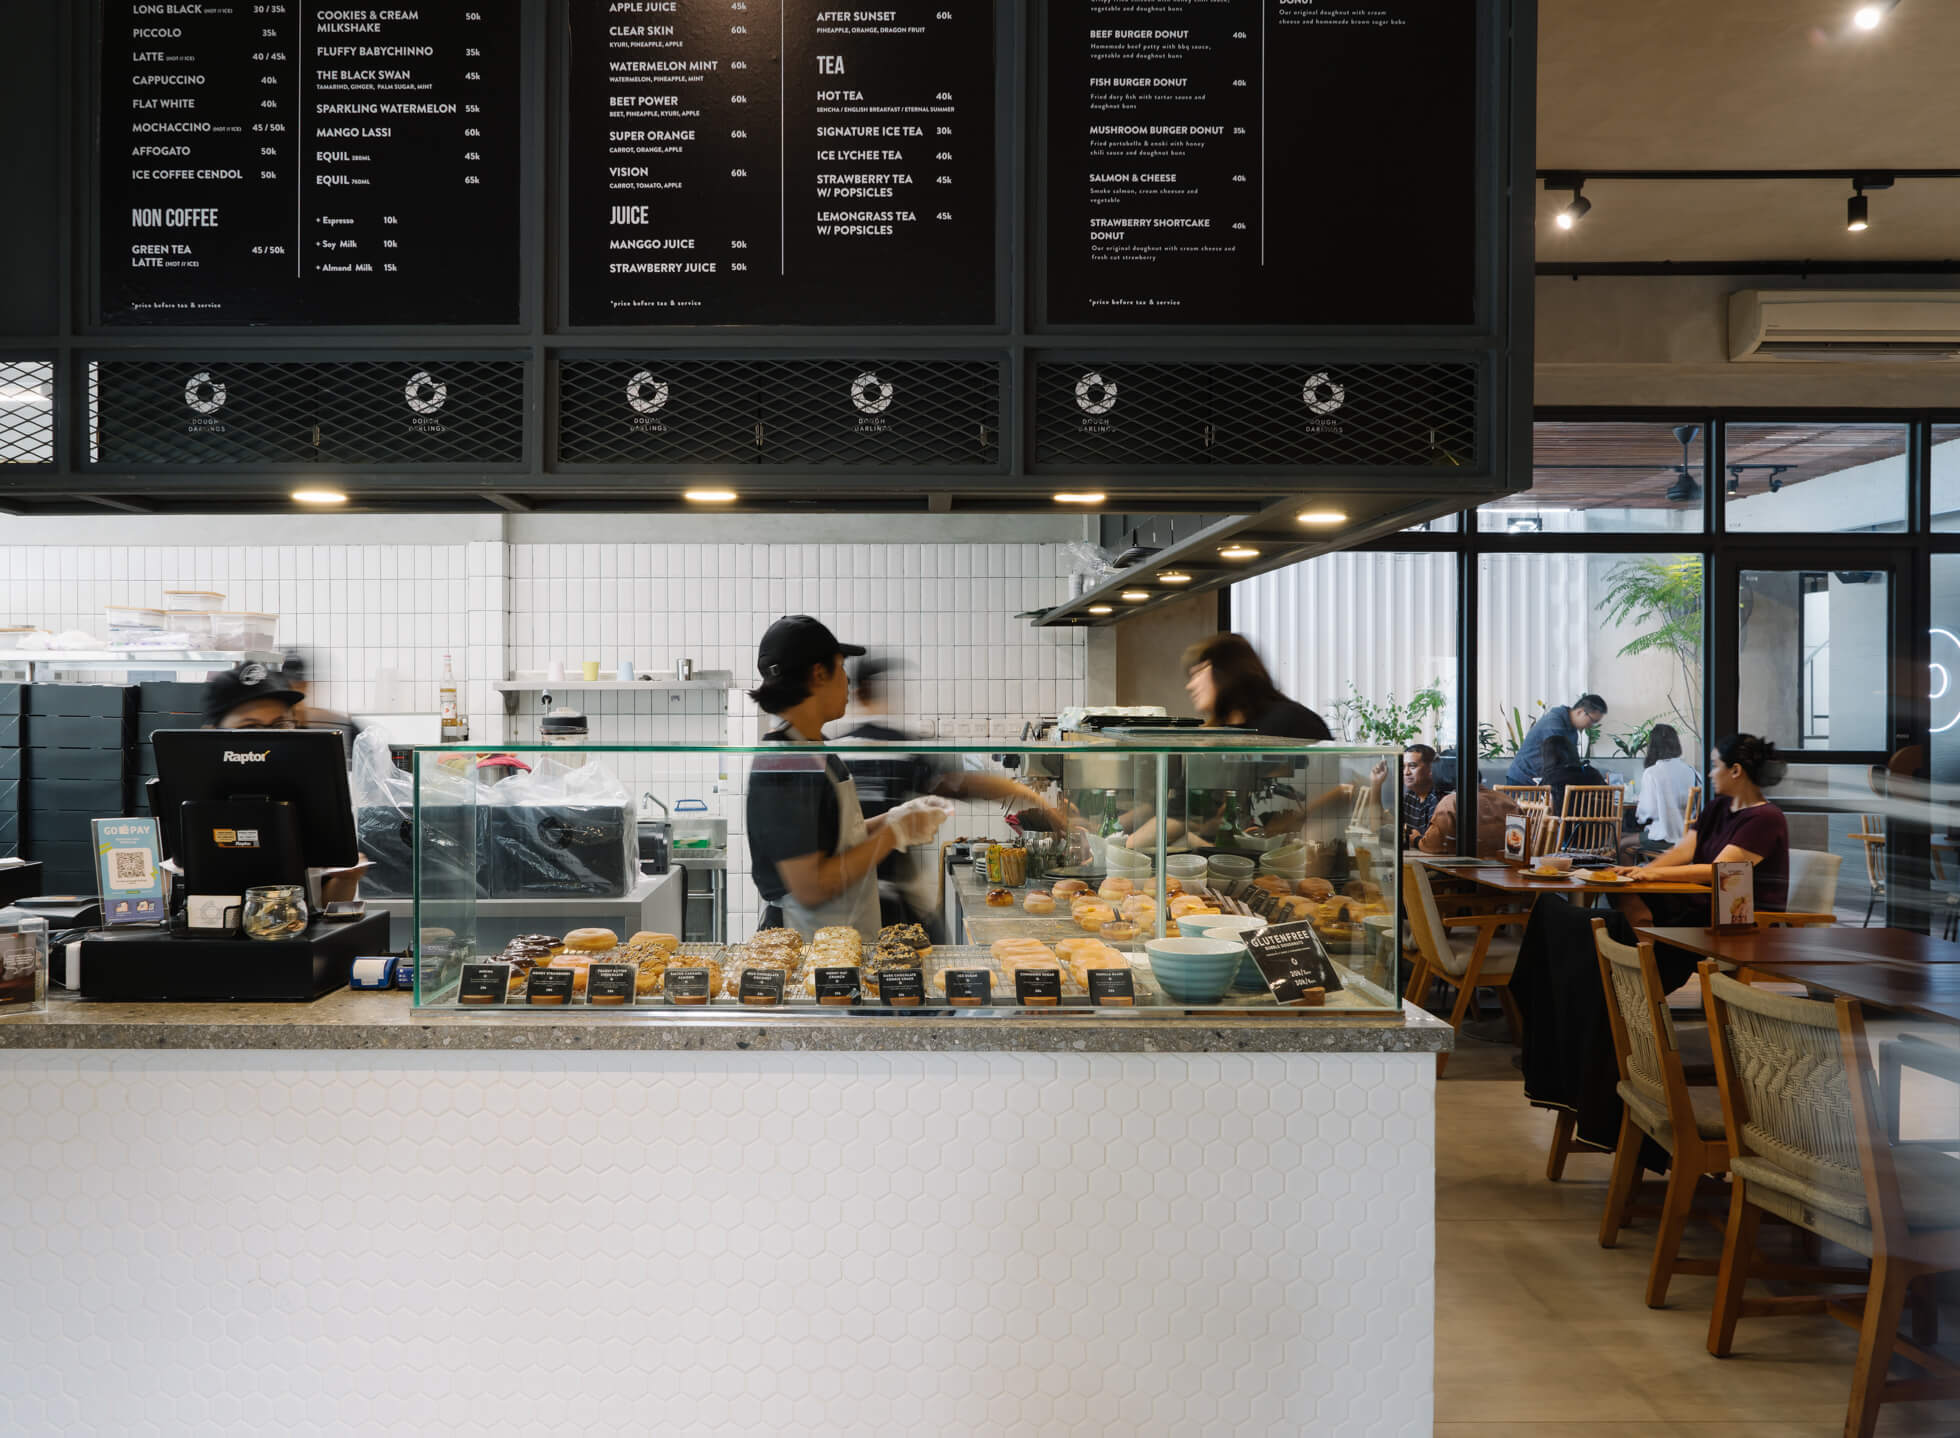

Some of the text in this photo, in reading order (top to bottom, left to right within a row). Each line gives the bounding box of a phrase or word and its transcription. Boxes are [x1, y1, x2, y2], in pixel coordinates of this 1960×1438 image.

[133, 4, 202, 14] LONG BLACK
[272, 5, 286, 13] 35k
[610, 2, 676, 12] APPLE JUICE
[317, 10, 418, 20] COOKIES & CREAM
[466, 12, 480, 20] 50k
[816, 12, 896, 22] AFTER SUNSET
[317, 23, 380, 32] MILKSHAKE
[610, 26, 674, 36] CLEAR SKIN
[731, 26, 747, 34] 60k
[133, 28, 182, 38] PICCOLO
[1090, 30, 1188, 38] BEEF BURGER DONUT
[318, 46, 433, 56] FLUFFY BABYCHINNO
[466, 48, 480, 56] 35k
[133, 52, 164, 61] LATTE
[610, 61, 718, 71] WATERMELON MINT
[731, 61, 746, 69] 60k
[816, 56, 844, 74] TEA
[132, 75, 205, 84] CAPPUCCINO
[316, 70, 410, 80] THE BLACK SWAN
[465, 72, 480, 80] 45k
[261, 76, 277, 84] 40k
[1090, 78, 1187, 86] FISH BURGER DONUT
[731, 95, 746, 103] 60k
[817, 91, 863, 100] HOT TEA
[936, 92, 952, 100] 40k
[133, 99, 195, 108] FLAT WHITE
[261, 100, 277, 108] 40k
[610, 96, 678, 106] BEET POWER
[317, 104, 456, 113] SPARKLING WATERMELON
[132, 122, 211, 132] MOCHACCINO
[817, 127, 923, 136] SIGNATURE ICE TEA
[1090, 126, 1224, 134] MUSHROOM BURGER DONUT
[316, 128, 391, 137] MANGO LASSI
[465, 128, 480, 136] 60k
[610, 130, 695, 140] SUPER ORANGE
[731, 130, 747, 138] 60k
[132, 146, 190, 156] AFFOGATO
[818, 150, 902, 160] ICE LYCHEE TEA
[317, 152, 350, 163] EQUIL
[465, 152, 480, 160] 45k
[936, 152, 952, 160] 40k
[132, 170, 243, 179] ICE COFFEE CENDOL
[610, 167, 648, 176] VISION
[316, 175, 350, 186] EQUIL
[465, 176, 480, 184] 65k
[817, 174, 912, 184] STRAWBERRY TEA
[936, 176, 952, 184] 45k
[1090, 174, 1176, 182] SALMON & CHEESE
[817, 188, 893, 197] W/ POPSICLES
[132, 208, 218, 226] NON COFFEE
[610, 206, 648, 224] JUICE
[818, 212, 916, 221] LEMONGRASS TEA
[936, 212, 952, 220] 45k
[323, 216, 354, 226] Espresso
[384, 216, 397, 224] 10k
[1154, 219, 1210, 227] SHORTCAKE
[817, 226, 893, 235] W/ POPSICLES
[1091, 232, 1124, 240] DONUT
[322, 240, 357, 250] Soy Milk
[384, 240, 397, 248] 10k
[610, 240, 694, 249] MANGGO JUICE
[732, 240, 746, 248] 50k
[132, 245, 192, 254] GREEN TEA
[132, 258, 163, 266] LATTE
[355, 264, 372, 272] Milk
[610, 263, 716, 272] STRAWBERRY JUICE
[223, 750, 271, 764] Raptor
[130, 825, 151, 835] PAY
[1250, 930, 1310, 948] GLUTENFREE
